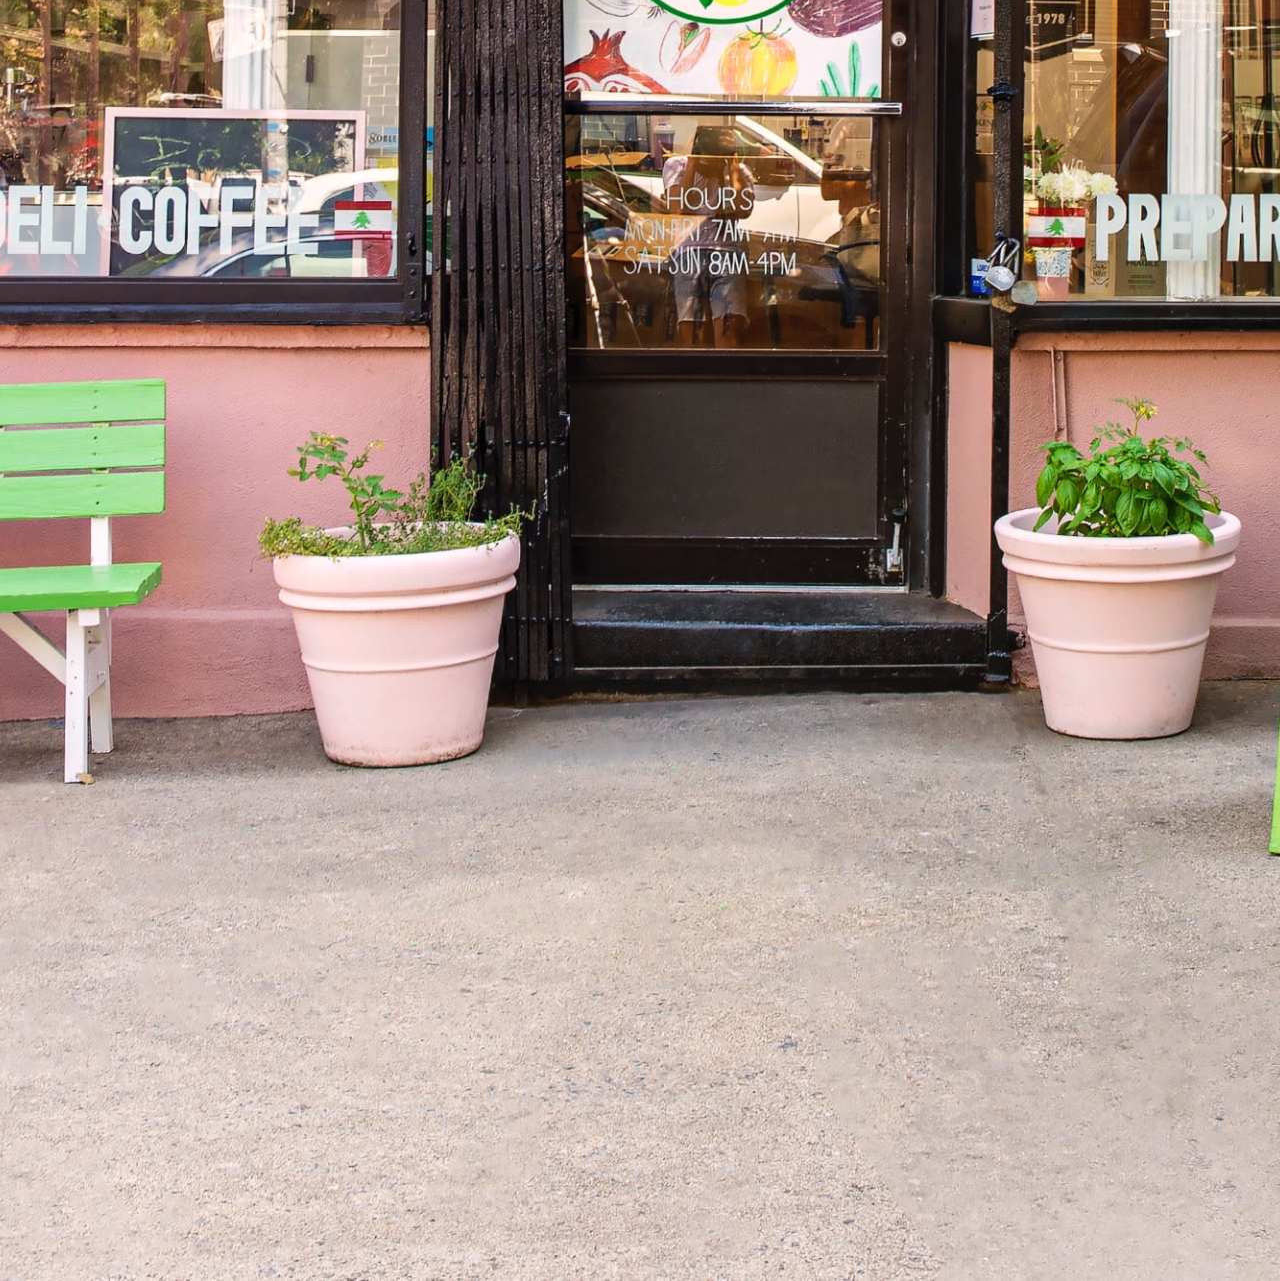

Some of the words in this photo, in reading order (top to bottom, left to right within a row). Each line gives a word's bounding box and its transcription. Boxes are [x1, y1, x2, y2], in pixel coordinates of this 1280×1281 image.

[1036, 13, 1066, 25] 1978
[666, 187, 753, 211] HOURS
[119, 185, 319, 256] COFFEE
